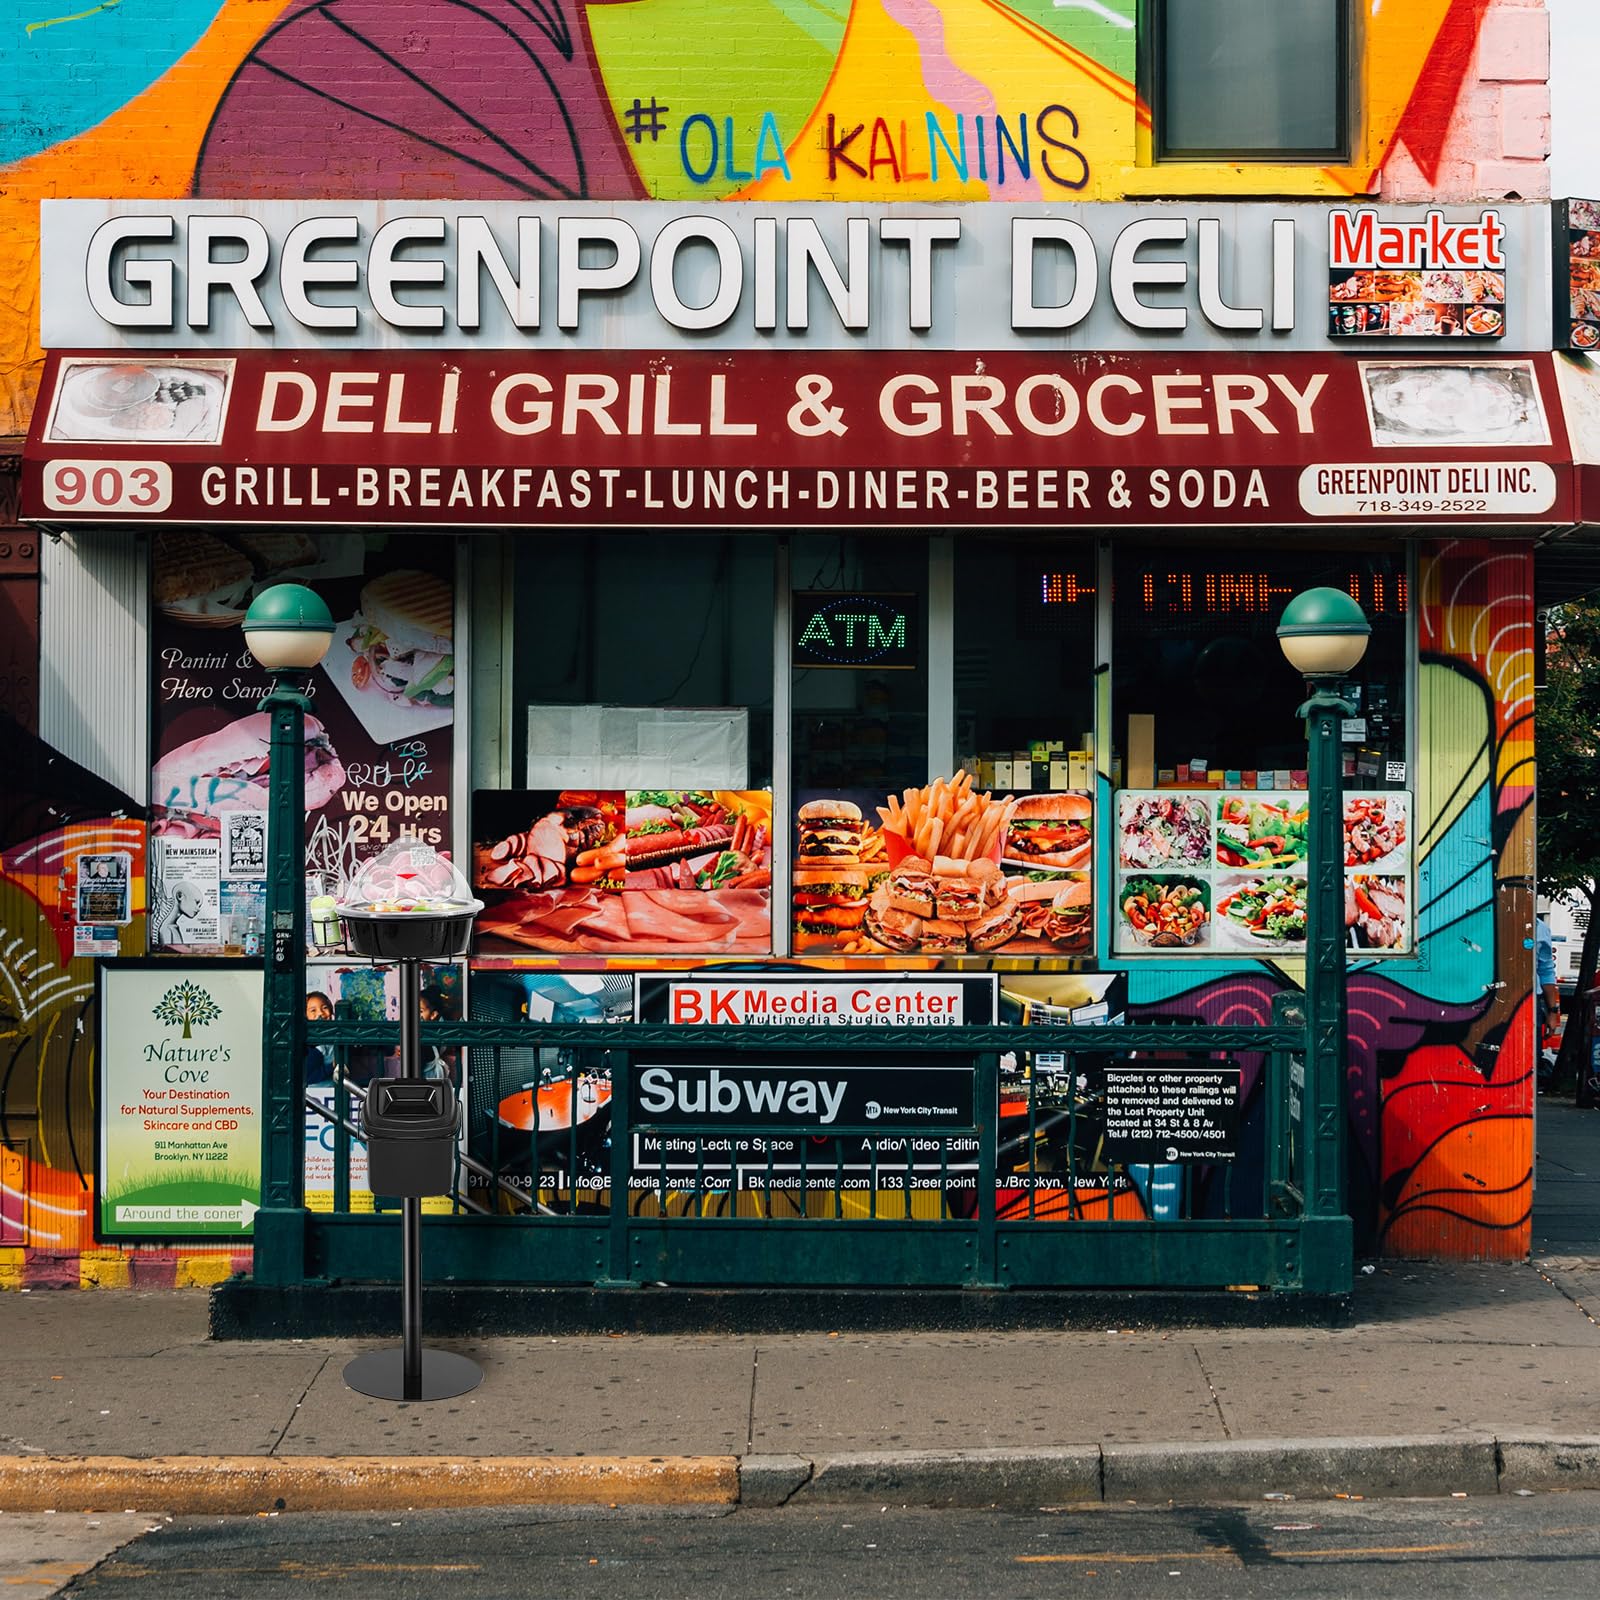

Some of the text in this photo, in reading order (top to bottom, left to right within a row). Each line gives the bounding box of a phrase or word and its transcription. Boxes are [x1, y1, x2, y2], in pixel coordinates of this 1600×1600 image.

[826, 104, 1090, 190] KALNINS
[1331, 212, 1505, 267] Market
[86, 215, 1295, 331] GREENPOINT DELI
[256, 371, 1329, 438] DELI GRILL & GROCERY
[54, 466, 161, 508] 903
[1107, 471, 1133, 509] &
[1149, 469, 1270, 508] SODA
[1317, 468, 1537, 495] GREENPOINT DELI INC.
[1356, 499, 1487, 512] 718-349-2522
[799, 613, 906, 648] ATM
[161, 648, 254, 669] Panini &
[161, 678, 316, 700] Hero Sandh
[341, 790, 448, 816] We Open
[348, 814, 442, 843] 24 Hrs
[674, 990, 959, 1024] BK Media Center
[744, 1013, 956, 1024] Multimedia Studio Rentals
[143, 1038, 232, 1063] Nature's
[164, 1065, 209, 1084] Cove
[1107, 1074, 1143, 1084] Bicycles
[1159, 1074, 1182, 1082] other
[1185, 1074, 1222, 1084] property
[143, 1089, 230, 1099] Your Destination
[639, 1068, 847, 1123] Subway
[1107, 1085, 1236, 1095] attached to these railings will
[1107, 1097, 1234, 1105] be removed and delivered to
[121, 1105, 254, 1116] for Natural Supplements,
[883, 1106, 899, 1114] New
[900, 1106, 916, 1114] York
[917, 1106, 932, 1116] City
[932, 1106, 957, 1114] Transit
[1107, 1108, 1205, 1117] the Lost Property Unit
[144, 1120, 239, 1130] Skincare and CBD
[1107, 1118, 1214, 1127] located at 34 St & 8 Av
[1107, 1129, 1226, 1139] Tel.# (212) 712-4500/4501
[155, 1141, 228, 1149] 911 Manhattan Ave
[645, 1138, 696, 1153] Meeting
[752, 1138, 794, 1153] Space
[946, 1138, 979, 1150] Editin
[122, 1207, 242, 1220] Around the coner
